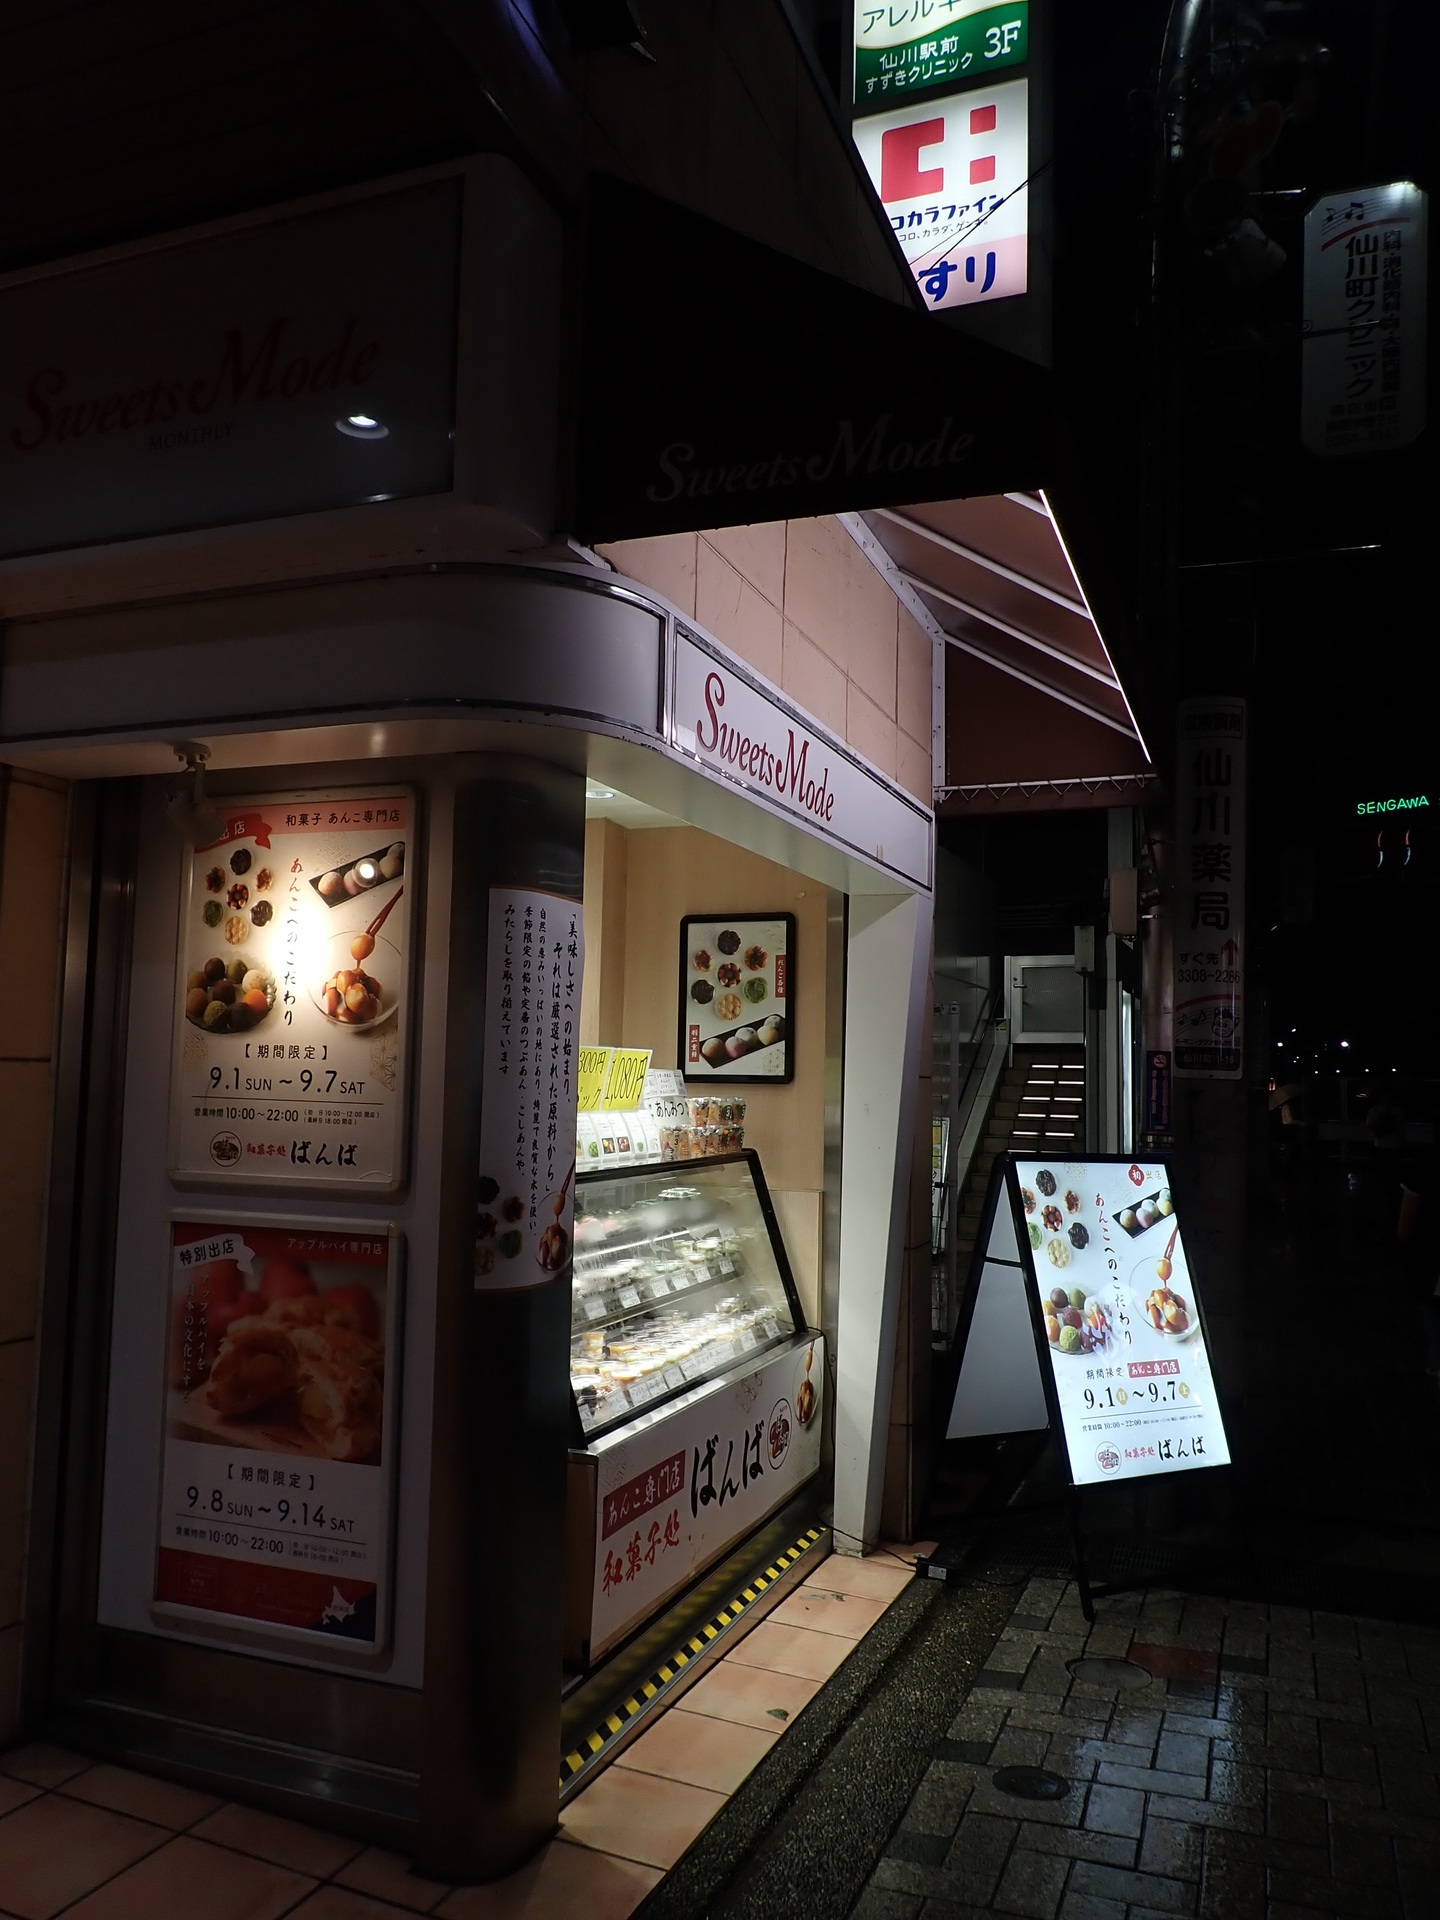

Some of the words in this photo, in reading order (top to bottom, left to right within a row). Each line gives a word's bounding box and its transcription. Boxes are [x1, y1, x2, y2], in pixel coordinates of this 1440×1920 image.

[880, 35, 960, 71] 仙川駅前
[984, 20, 1022, 59] 3F
[865, 52, 973, 94] すずきクリニック
[917, 251, 996, 303] すり
[1345, 233, 1379, 399] 仙川町クリニック
[10, 367, 187, 451] Sweets
[187, 316, 382, 416] Mode
[148, 422, 235, 453] MONTHLY
[645, 441, 802, 503] Sweets
[803, 411, 979, 483] Mode
[696, 671, 775, 787] Sweets
[775, 727, 835, 823] Mode
[286, 812, 322, 827] 和菓子
[328, 809, 400, 825] あんこ専門店
[1357, 795, 1430, 815] SENGAWA
[1191, 747, 1232, 931] 仙川薬局
[282, 857, 304, 1026] あんこへのこだわり
[1179, 952, 1220, 966] すぐ先
[1177, 968, 1241, 984] 3308-2286
[210, 1066, 240, 1090] 9.1
[245, 1078, 272, 1091] SUN
[300, 1069, 338, 1093] 9.7
[340, 1081, 366, 1095] SAT
[604, 1055, 649, 1108] 1,080円
[193, 1107, 224, 1118] 営業時間
[654, 1100, 686, 1119] あんみつ
[246, 1142, 287, 1158] 和菓子処
[290, 1139, 359, 1168] ばんば
[179, 1238, 234, 1266] 特別出店
[287, 1237, 384, 1256] アップルパイ専門店
[1095, 1193, 1133, 1346] あんこへのこだわり
[1086, 1367, 1124, 1380] 期間限定
[1130, 1361, 1180, 1376] あんこ専門店
[1084, 1387, 1115, 1410] 9.1
[1148, 1381, 1176, 1403] 9.7
[1124, 1445, 1155, 1460] 和菓子処
[1158, 1436, 1208, 1462] ばんば
[690, 1419, 765, 1520] ばんば
[187, 1486, 223, 1513] 9.8
[227, 1502, 253, 1517] SUN
[278, 1499, 326, 1528] 9.14
[330, 1517, 355, 1533] SAT
[606, 1459, 682, 1528] あんこ専門店
[175, 1526, 207, 1541] 営業時間
[601, 1507, 681, 1598] 和菓子処
